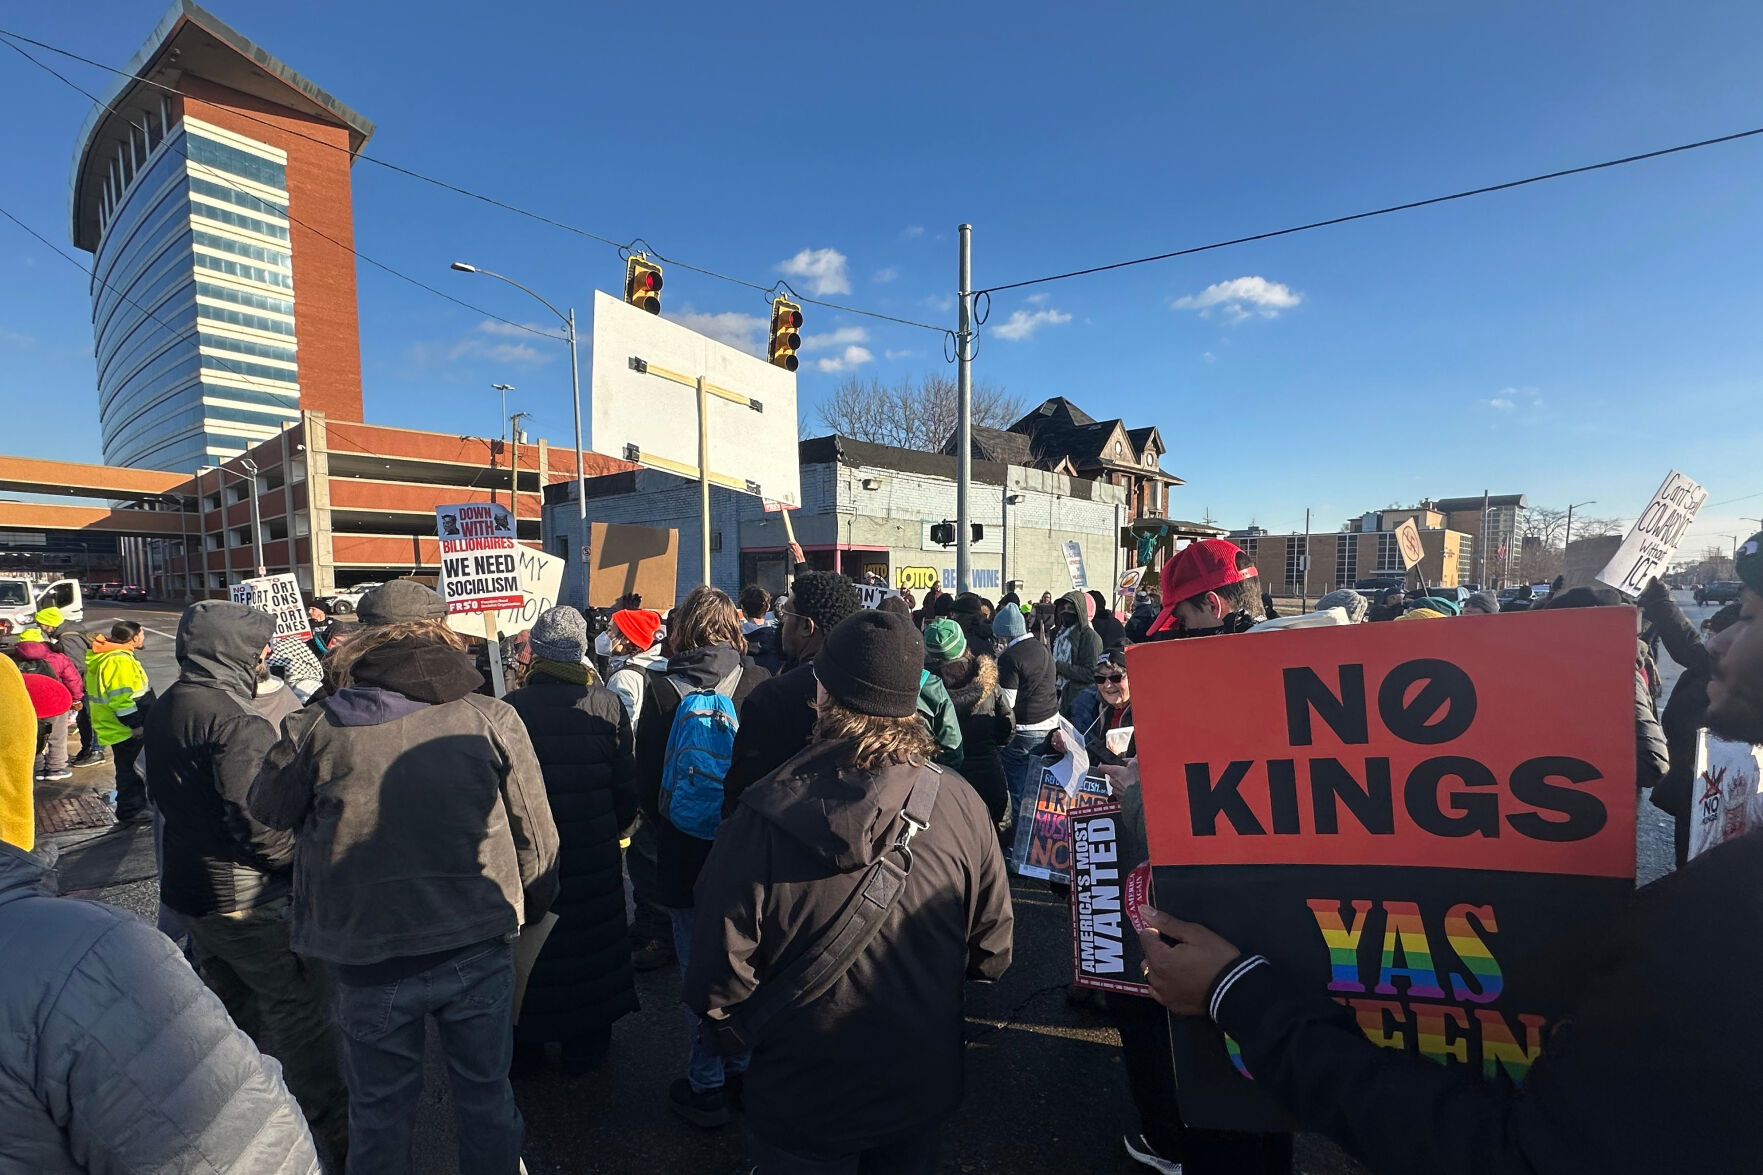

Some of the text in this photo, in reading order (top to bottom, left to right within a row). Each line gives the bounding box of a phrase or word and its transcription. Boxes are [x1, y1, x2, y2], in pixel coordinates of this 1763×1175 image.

[459, 507, 492, 520] DOWN
[460, 520, 495, 537] WITH
[443, 537, 515, 553] BILLIONAIRES
[443, 554, 516, 578] WE NEED
[520, 551, 548, 582] MY
[896, 566, 999, 589] LOTTO BE WINE
[1622, 555, 1658, 591] ICE
[271, 581, 295, 594] ORT
[447, 576, 518, 597] SOCIALISM
[857, 587, 888, 603] AN'T
[271, 593, 298, 607] ONS
[1184, 756, 1608, 842] KINGS
[1704, 796, 1719, 817] NO
[1034, 811, 1068, 840] MUS
[1030, 836, 1069, 869] NO
[1074, 821, 1096, 973] AMERICA'S MOST
[1087, 817, 1125, 974] WANTED
[1127, 872, 1136, 911] AMERICA
[1306, 899, 1504, 1004] YAS
